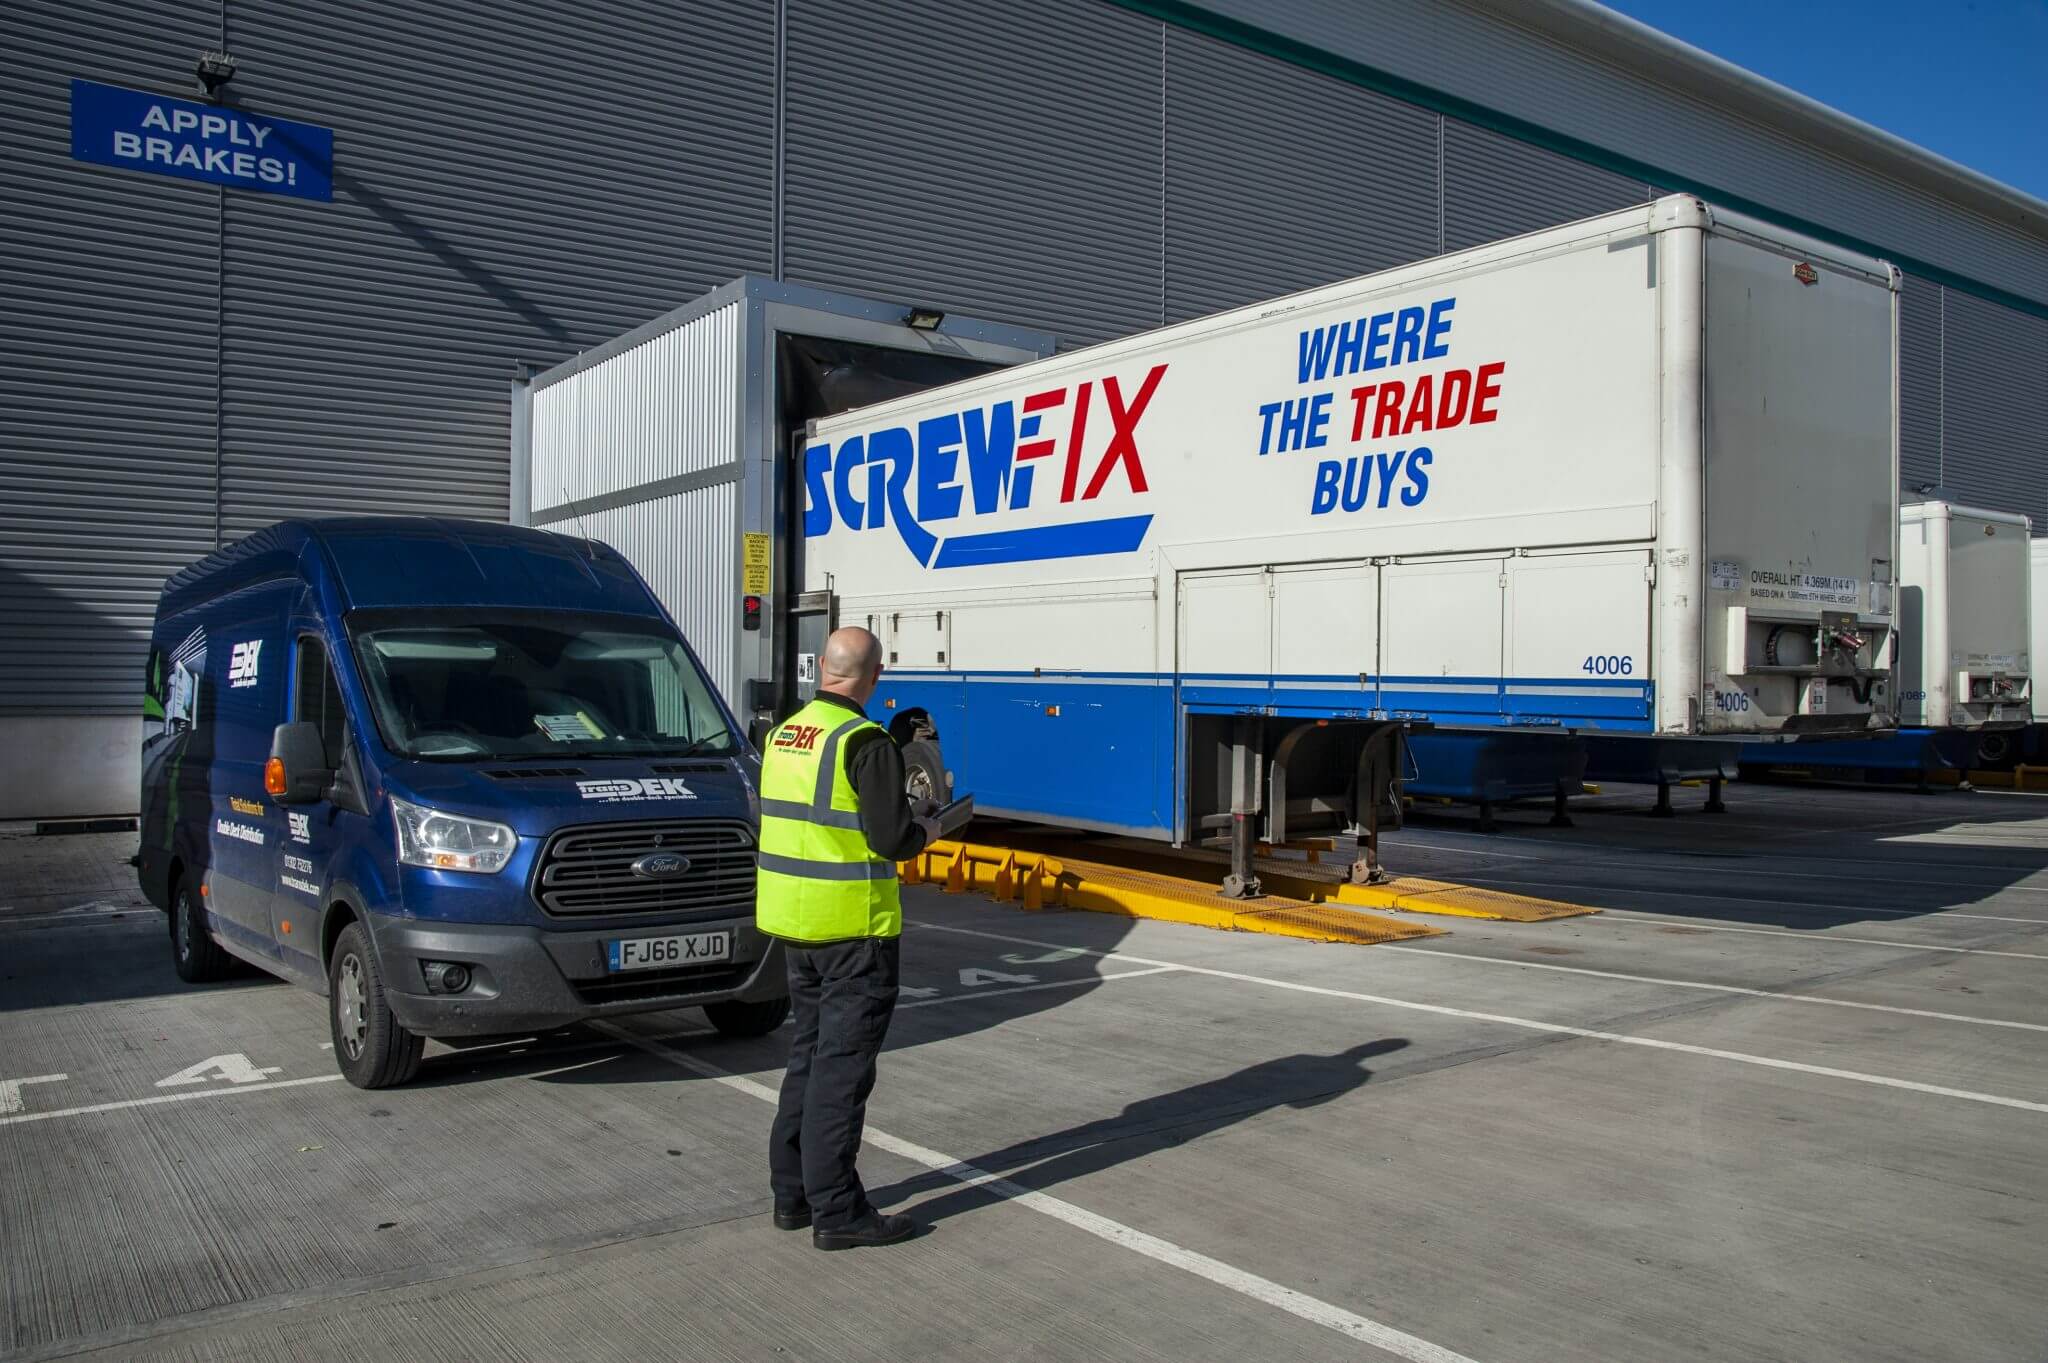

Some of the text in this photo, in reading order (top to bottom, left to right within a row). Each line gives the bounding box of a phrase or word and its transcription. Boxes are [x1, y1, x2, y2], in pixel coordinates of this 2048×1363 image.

[141, 105, 272, 149] APPLY
[113, 131, 296, 186] BRAKES!
[1298, 297, 1456, 384] WHERE
[1258, 361, 1506, 456] THE TRADE
[804, 363, 1169, 569] SCREWFIX
[1311, 446, 1433, 515] BUYS
[1751, 570, 1788, 585] OVERALL
[1583, 656, 1633, 675] 4006
[1716, 692, 1749, 711] 4006
[651, 858, 680, 872] Ford
[623, 935, 724, 964] FJ66 XJD
